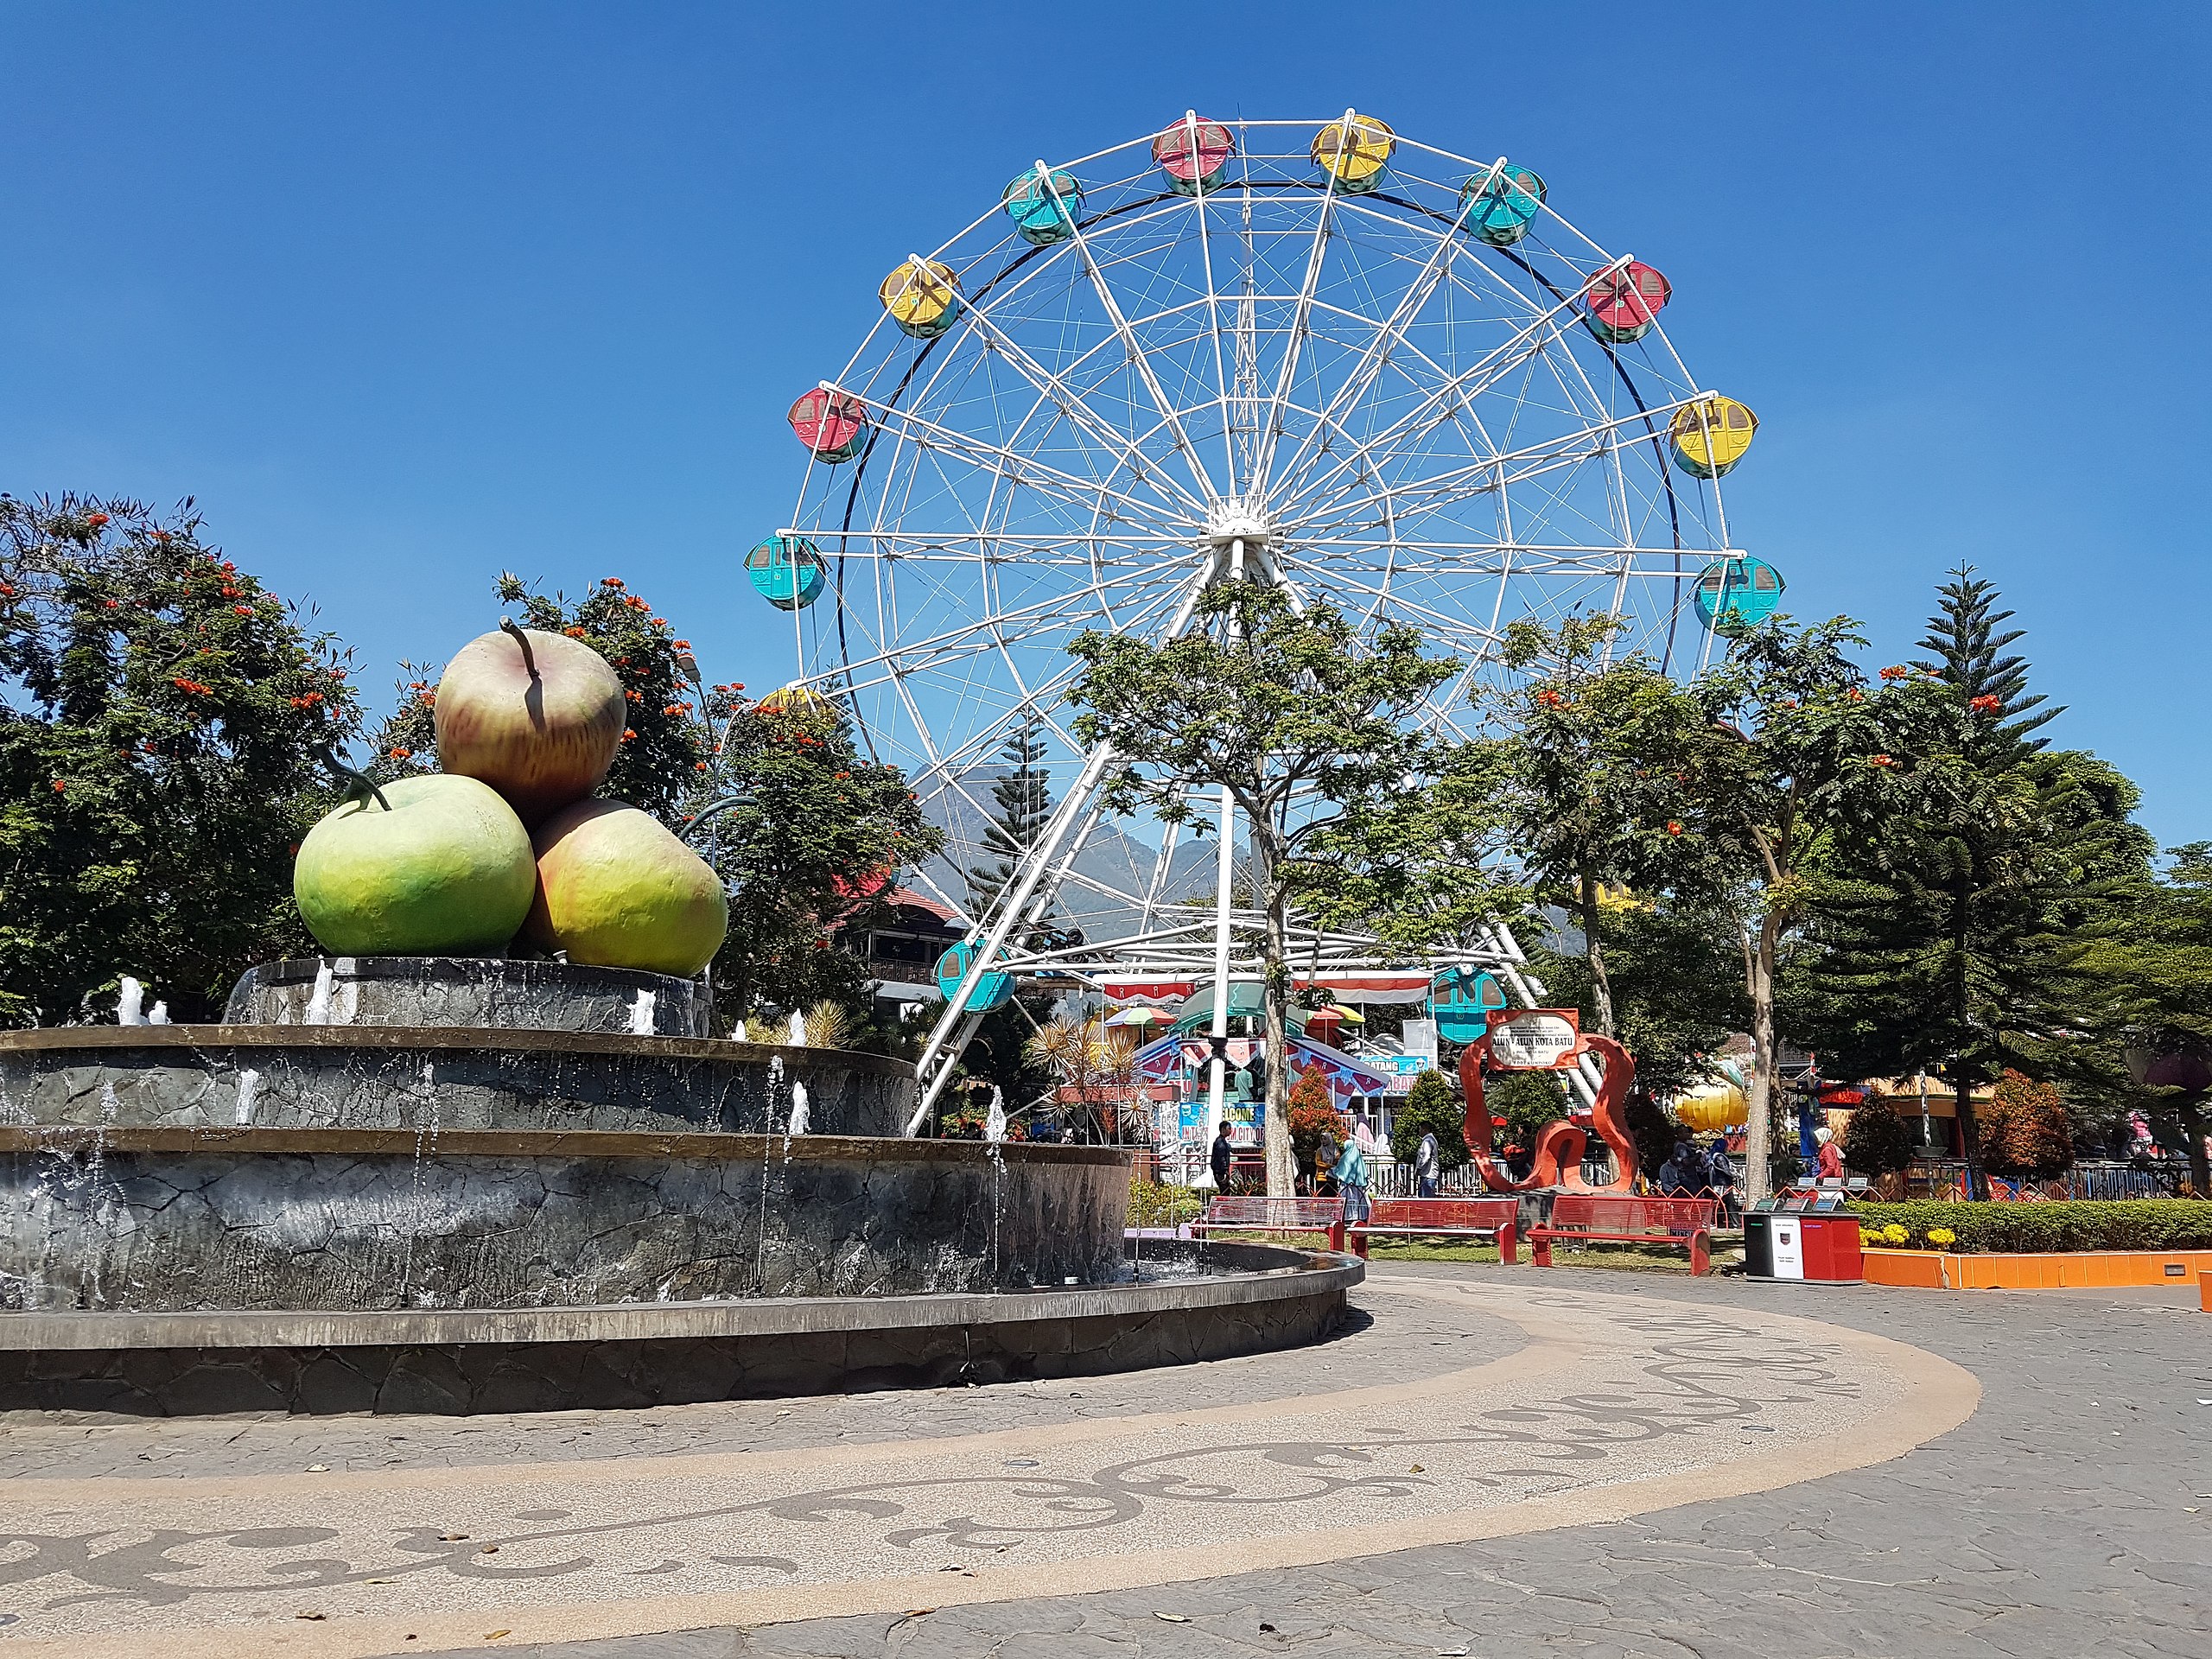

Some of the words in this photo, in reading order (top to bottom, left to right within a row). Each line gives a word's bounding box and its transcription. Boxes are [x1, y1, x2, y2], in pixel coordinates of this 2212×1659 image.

[1492, 1037, 1510, 1046] ALUN
[1516, 1037, 1534, 1046] ALUN
[1535, 1037, 1553, 1046] KOTA
[1554, 1037, 1573, 1046] BATU
[1393, 1077, 1418, 1090] BAT
[1238, 1127, 1255, 1141] CITY
[1255, 1127, 1264, 1141] OF
